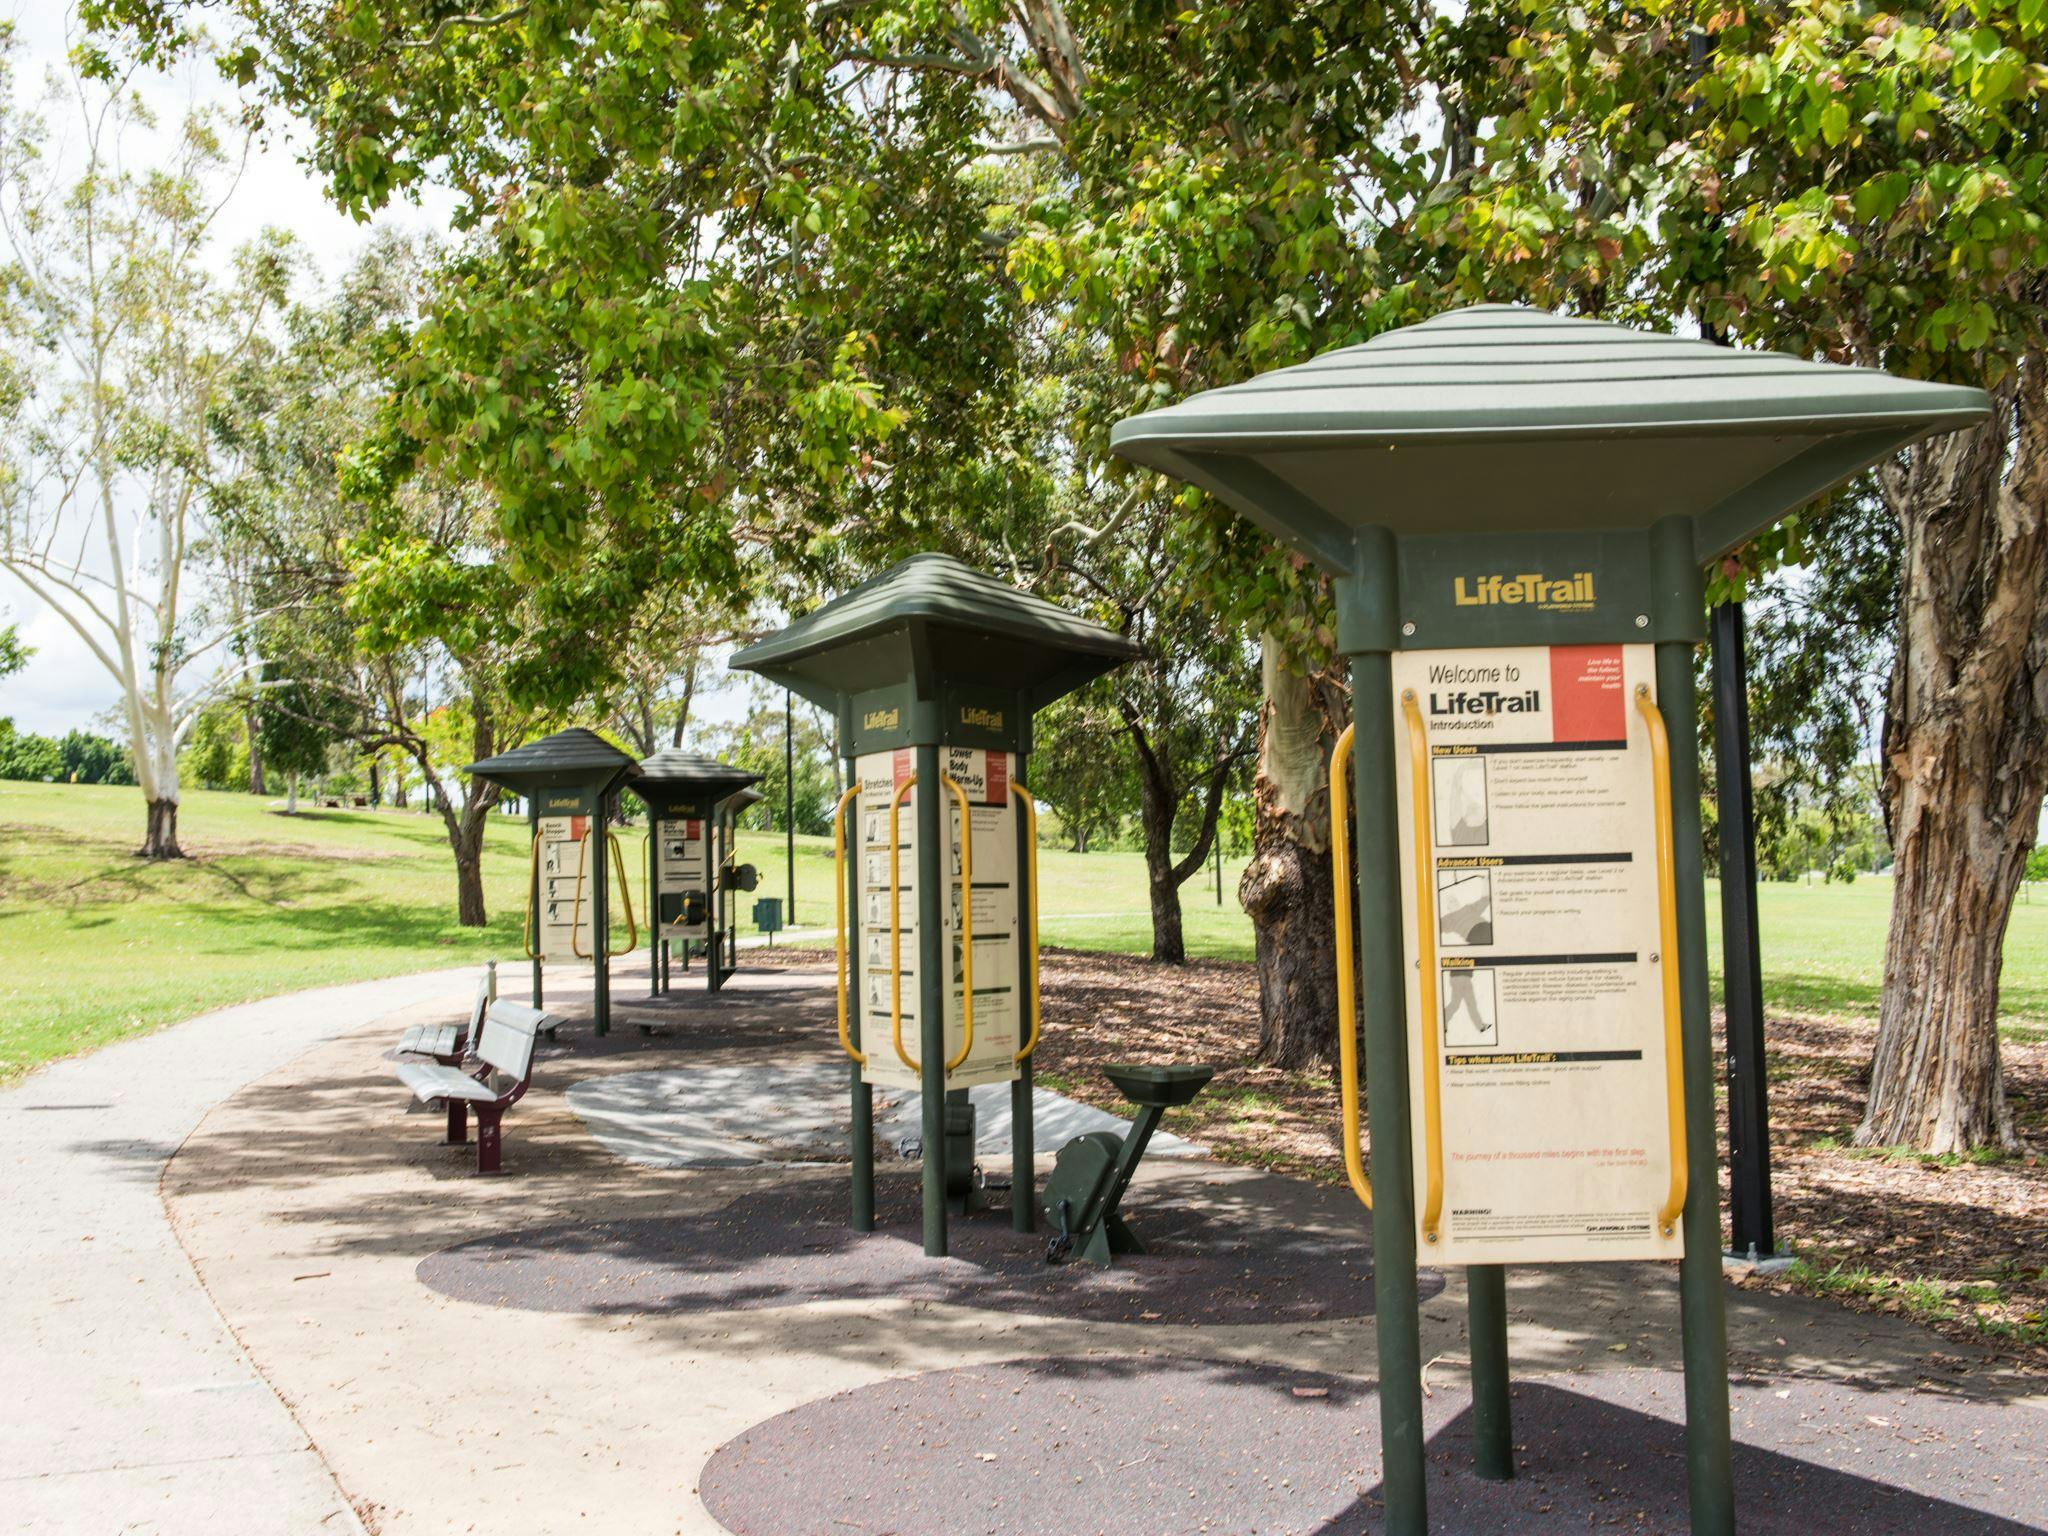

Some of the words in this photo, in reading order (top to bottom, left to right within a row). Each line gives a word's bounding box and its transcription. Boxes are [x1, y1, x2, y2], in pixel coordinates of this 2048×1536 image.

[1454, 572, 1595, 606] LifeTrail
[1429, 665, 1500, 684] Welcome
[1505, 664, 1520, 682] to
[1430, 690, 1540, 715] LifeTrail
[864, 708, 899, 730] LifeTrail
[961, 706, 1004, 729] LifeTrail
[1430, 719, 1494, 731] Introduction
